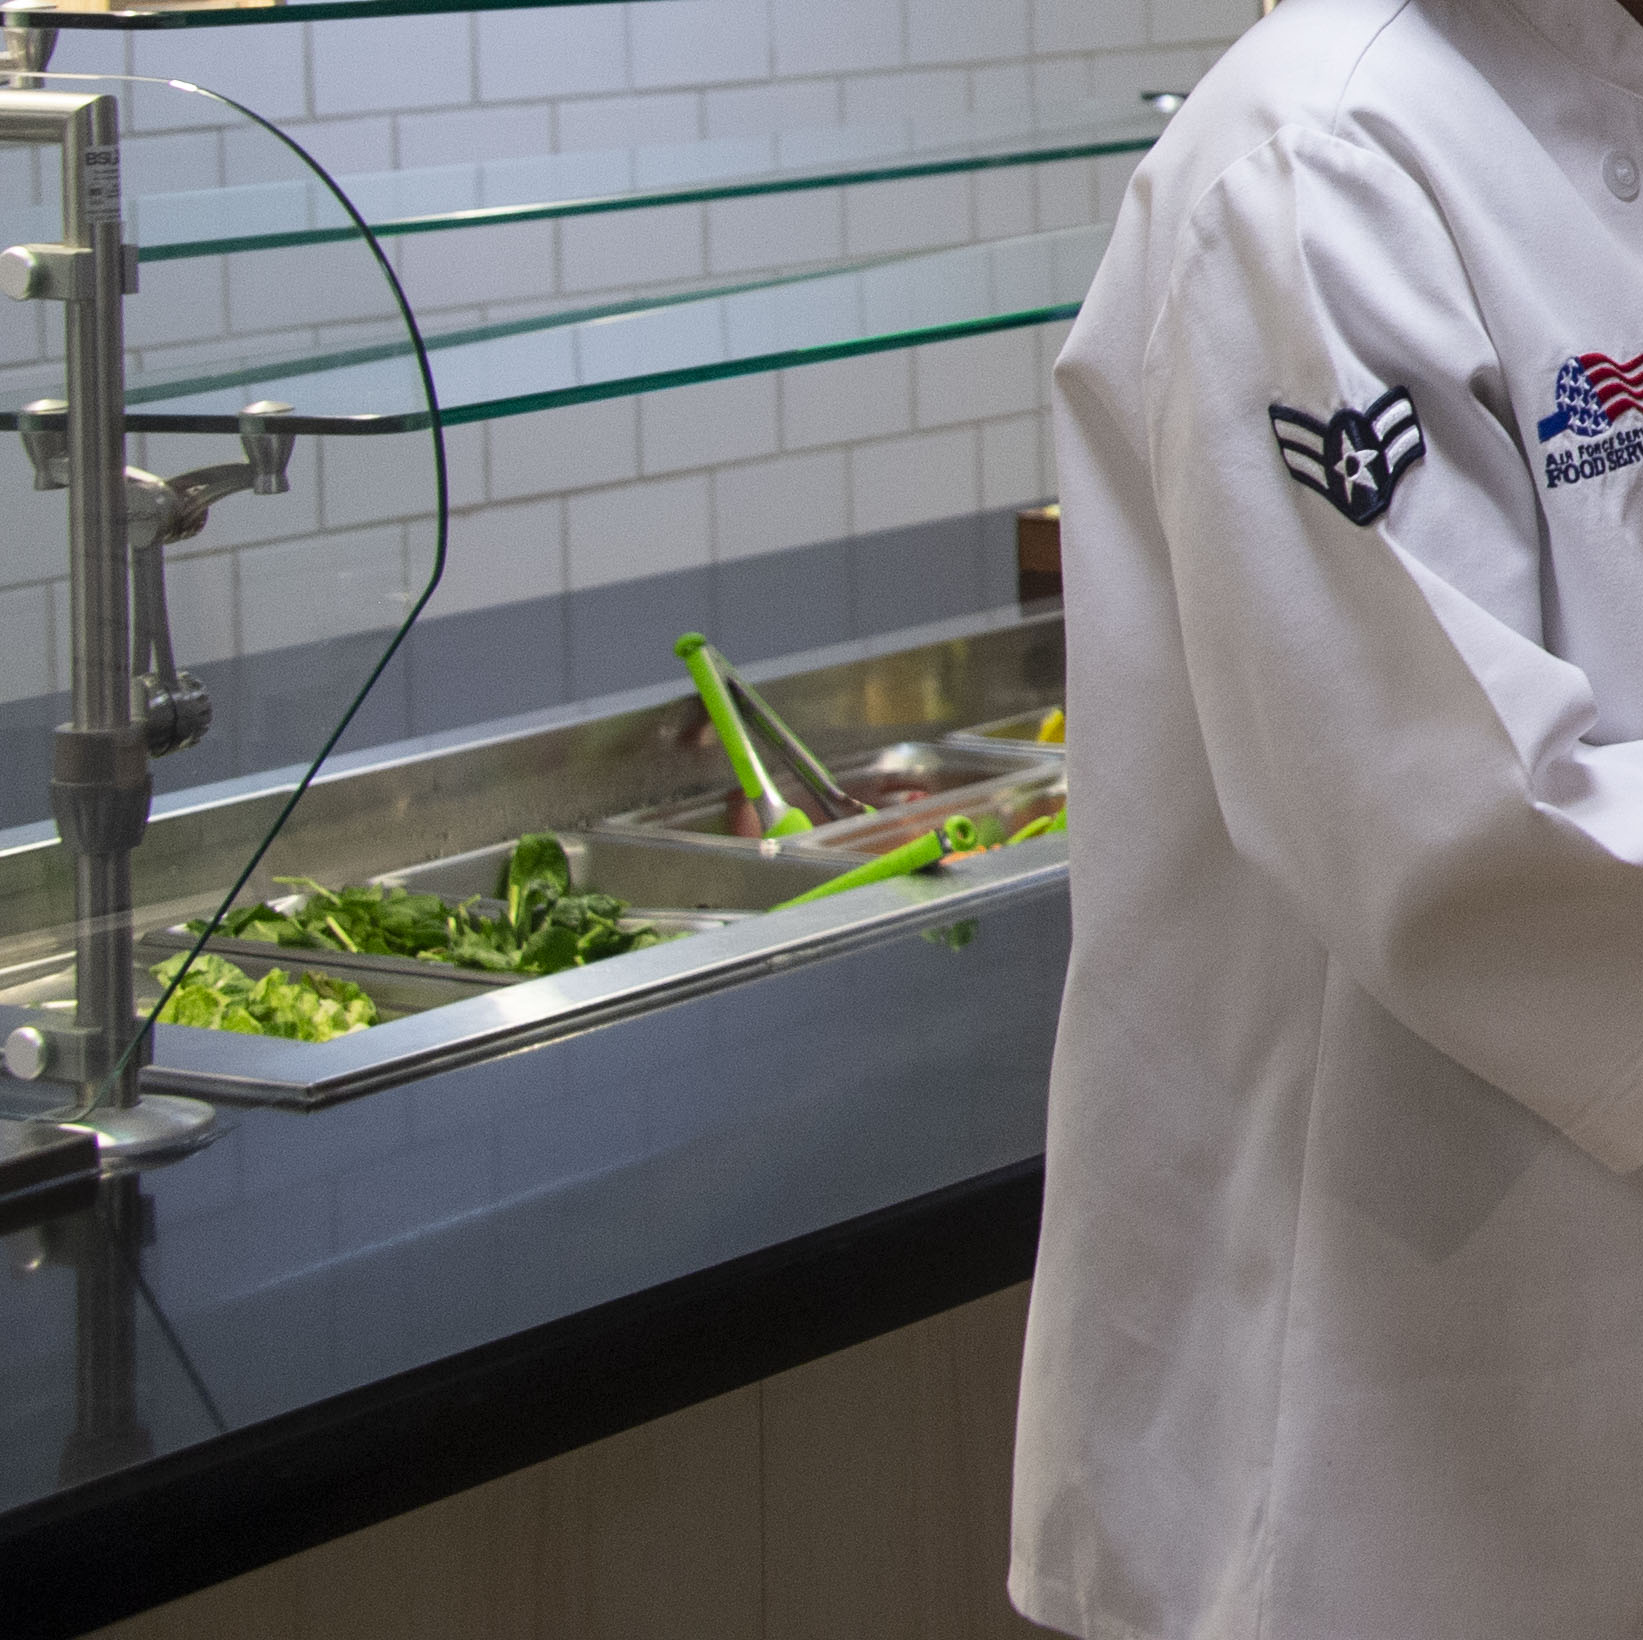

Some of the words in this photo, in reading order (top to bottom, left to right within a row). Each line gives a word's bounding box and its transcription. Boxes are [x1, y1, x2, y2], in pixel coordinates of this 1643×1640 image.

[1545, 450, 1574, 468] AIR
[1577, 436, 1616, 460] FORCE
[1545, 457, 1606, 489] FOOD
